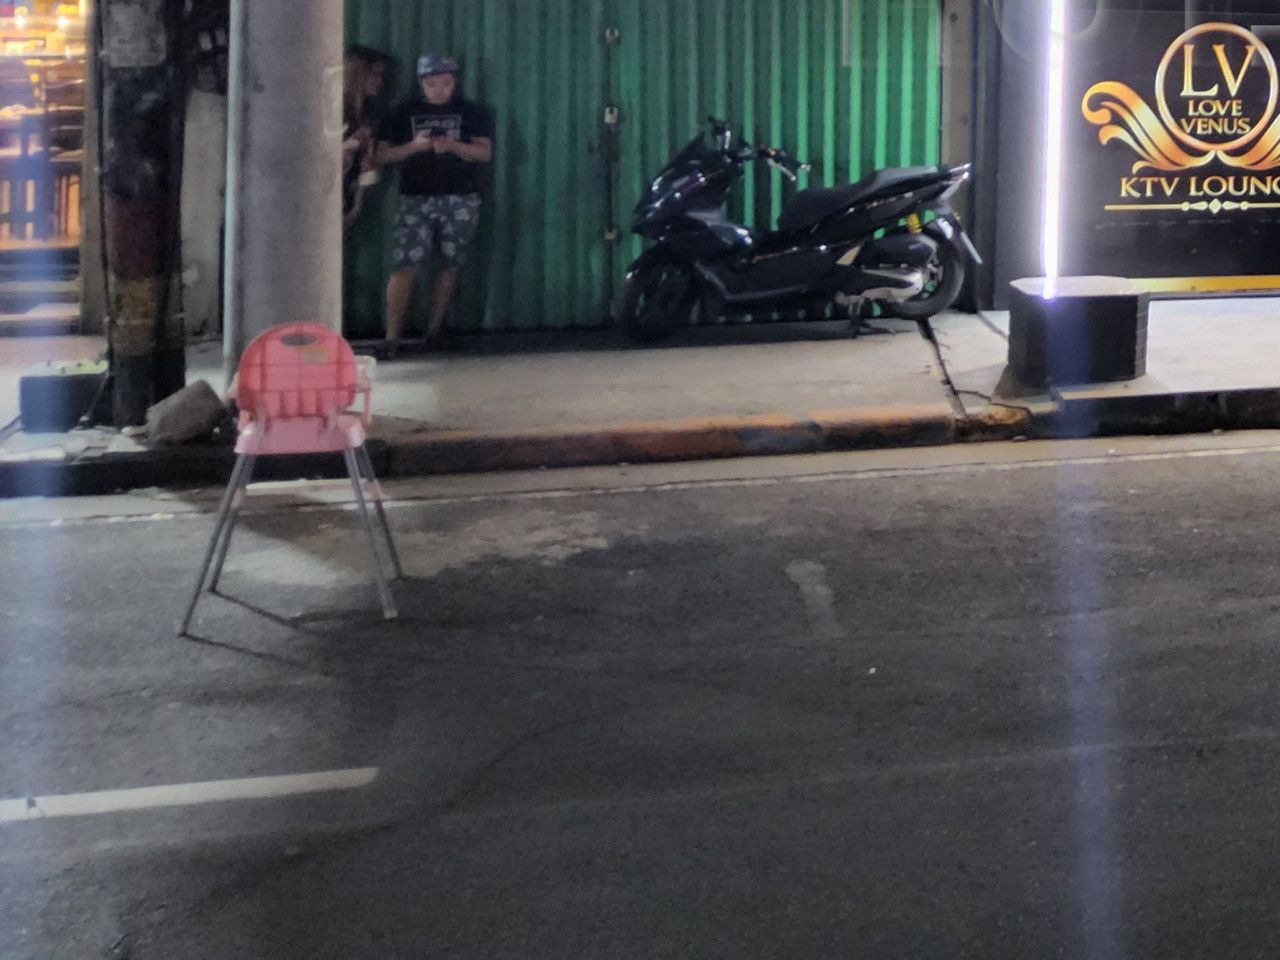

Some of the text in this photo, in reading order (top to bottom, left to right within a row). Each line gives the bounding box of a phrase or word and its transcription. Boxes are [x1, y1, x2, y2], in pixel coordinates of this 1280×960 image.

[1180, 43, 1256, 97] LV
[1188, 99, 1243, 117] LOVE
[1181, 117, 1252, 135] VENUS
[1120, 176, 1181, 198] KTV
